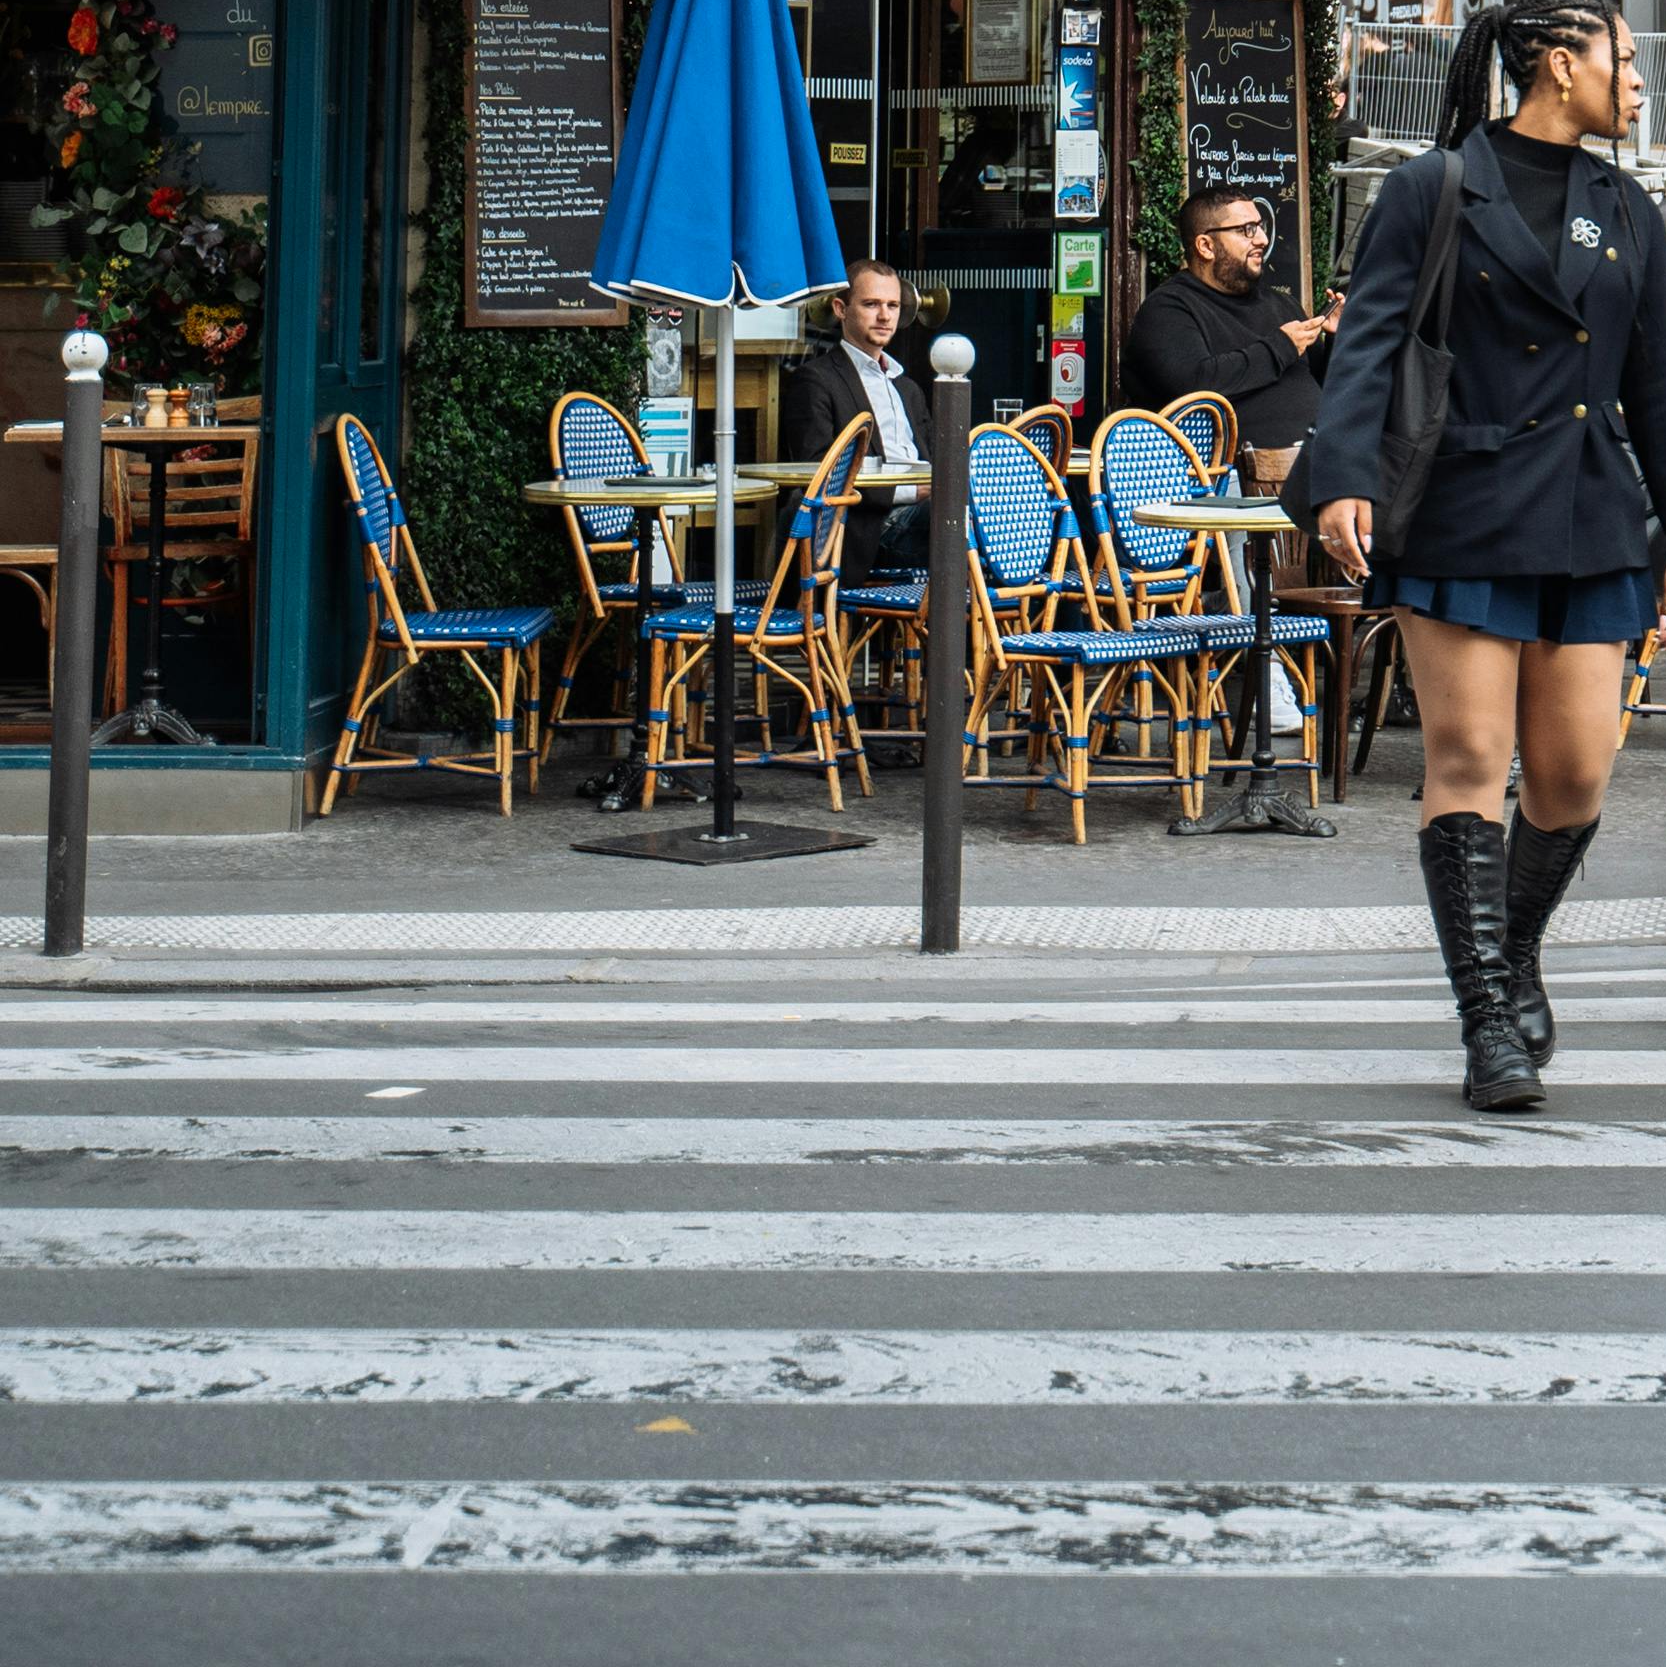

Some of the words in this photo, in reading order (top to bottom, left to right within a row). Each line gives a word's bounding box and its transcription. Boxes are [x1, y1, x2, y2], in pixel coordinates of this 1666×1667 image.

[1063, 52, 1093, 66] sodexo
[833, 146, 864, 161] POUSSEZ
[1064, 238, 1096, 252] Carte
